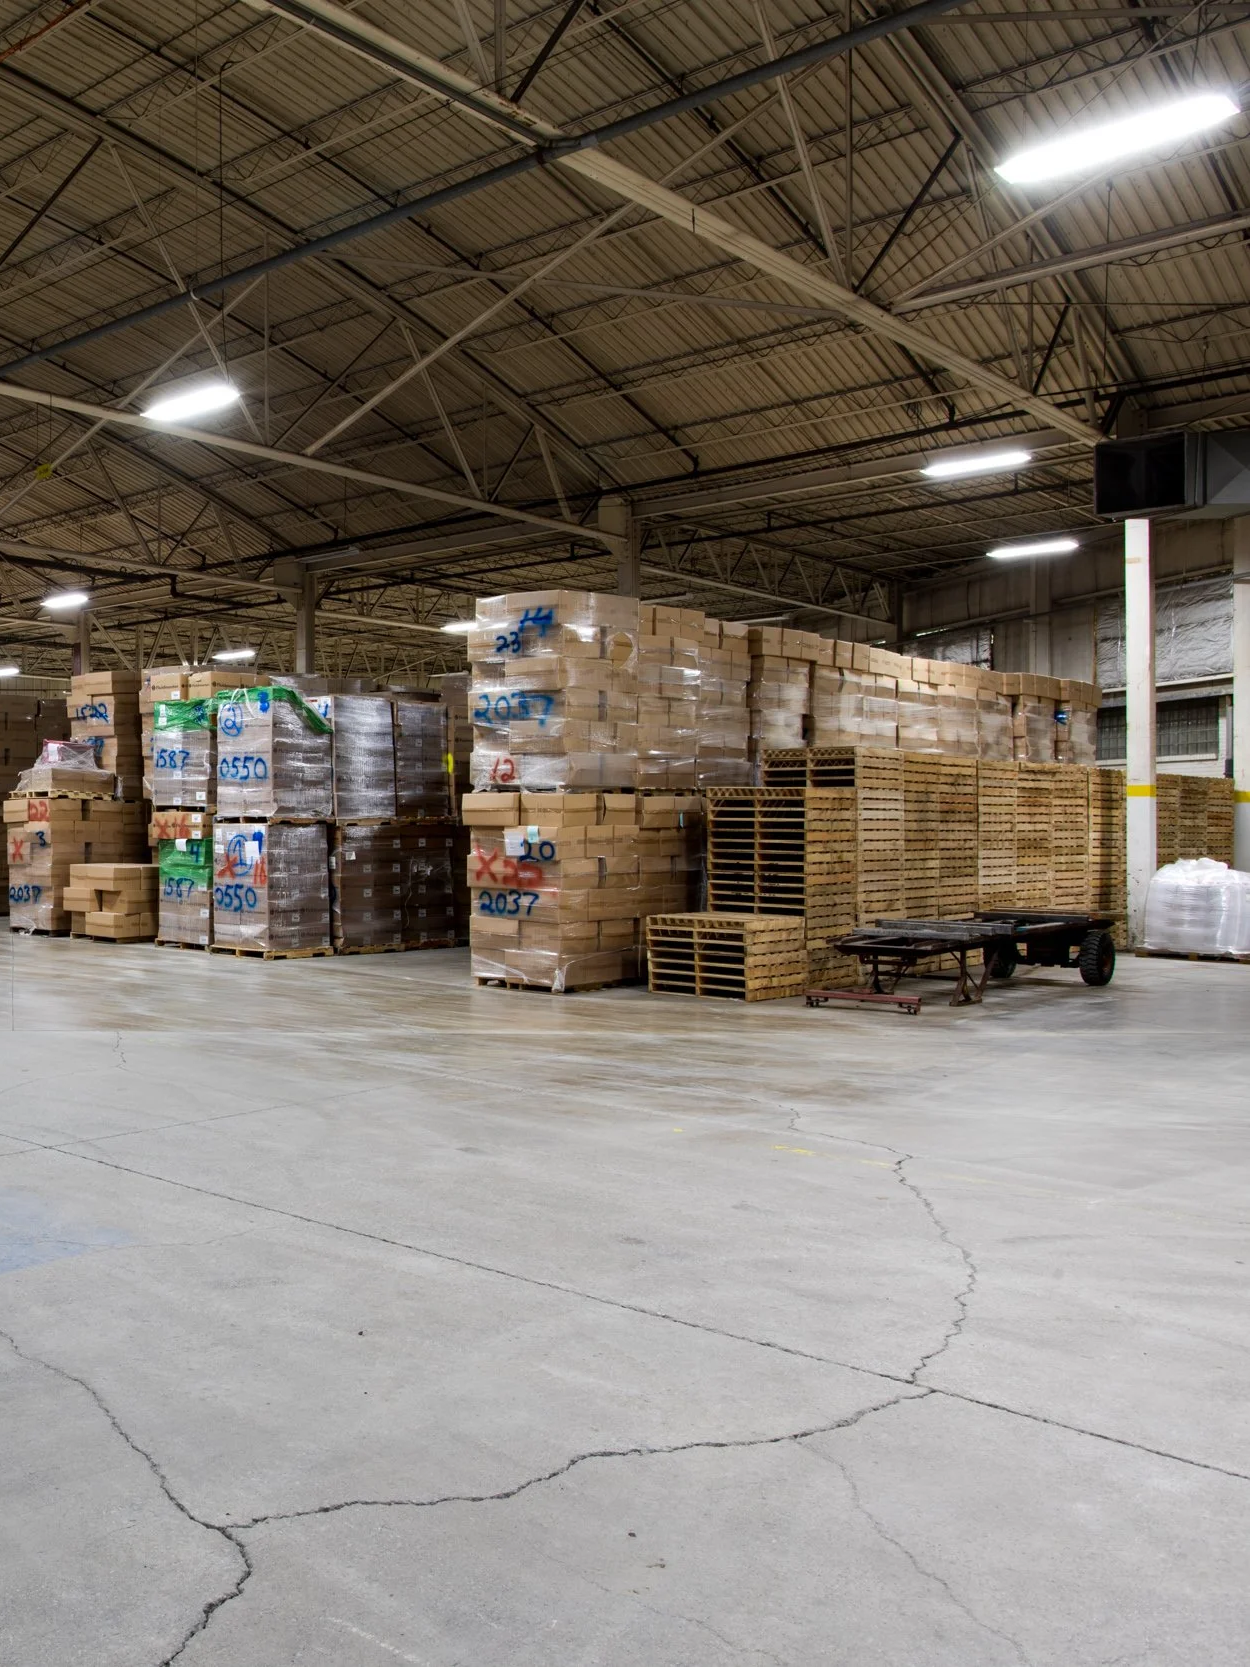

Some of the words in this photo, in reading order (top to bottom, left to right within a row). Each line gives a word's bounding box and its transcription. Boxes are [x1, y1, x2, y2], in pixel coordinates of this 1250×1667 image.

[155, 749, 190, 770] 1587
[219, 755, 268, 780] 0550
[214, 884, 258, 912] 0550
[479, 889, 540, 916] 2037
